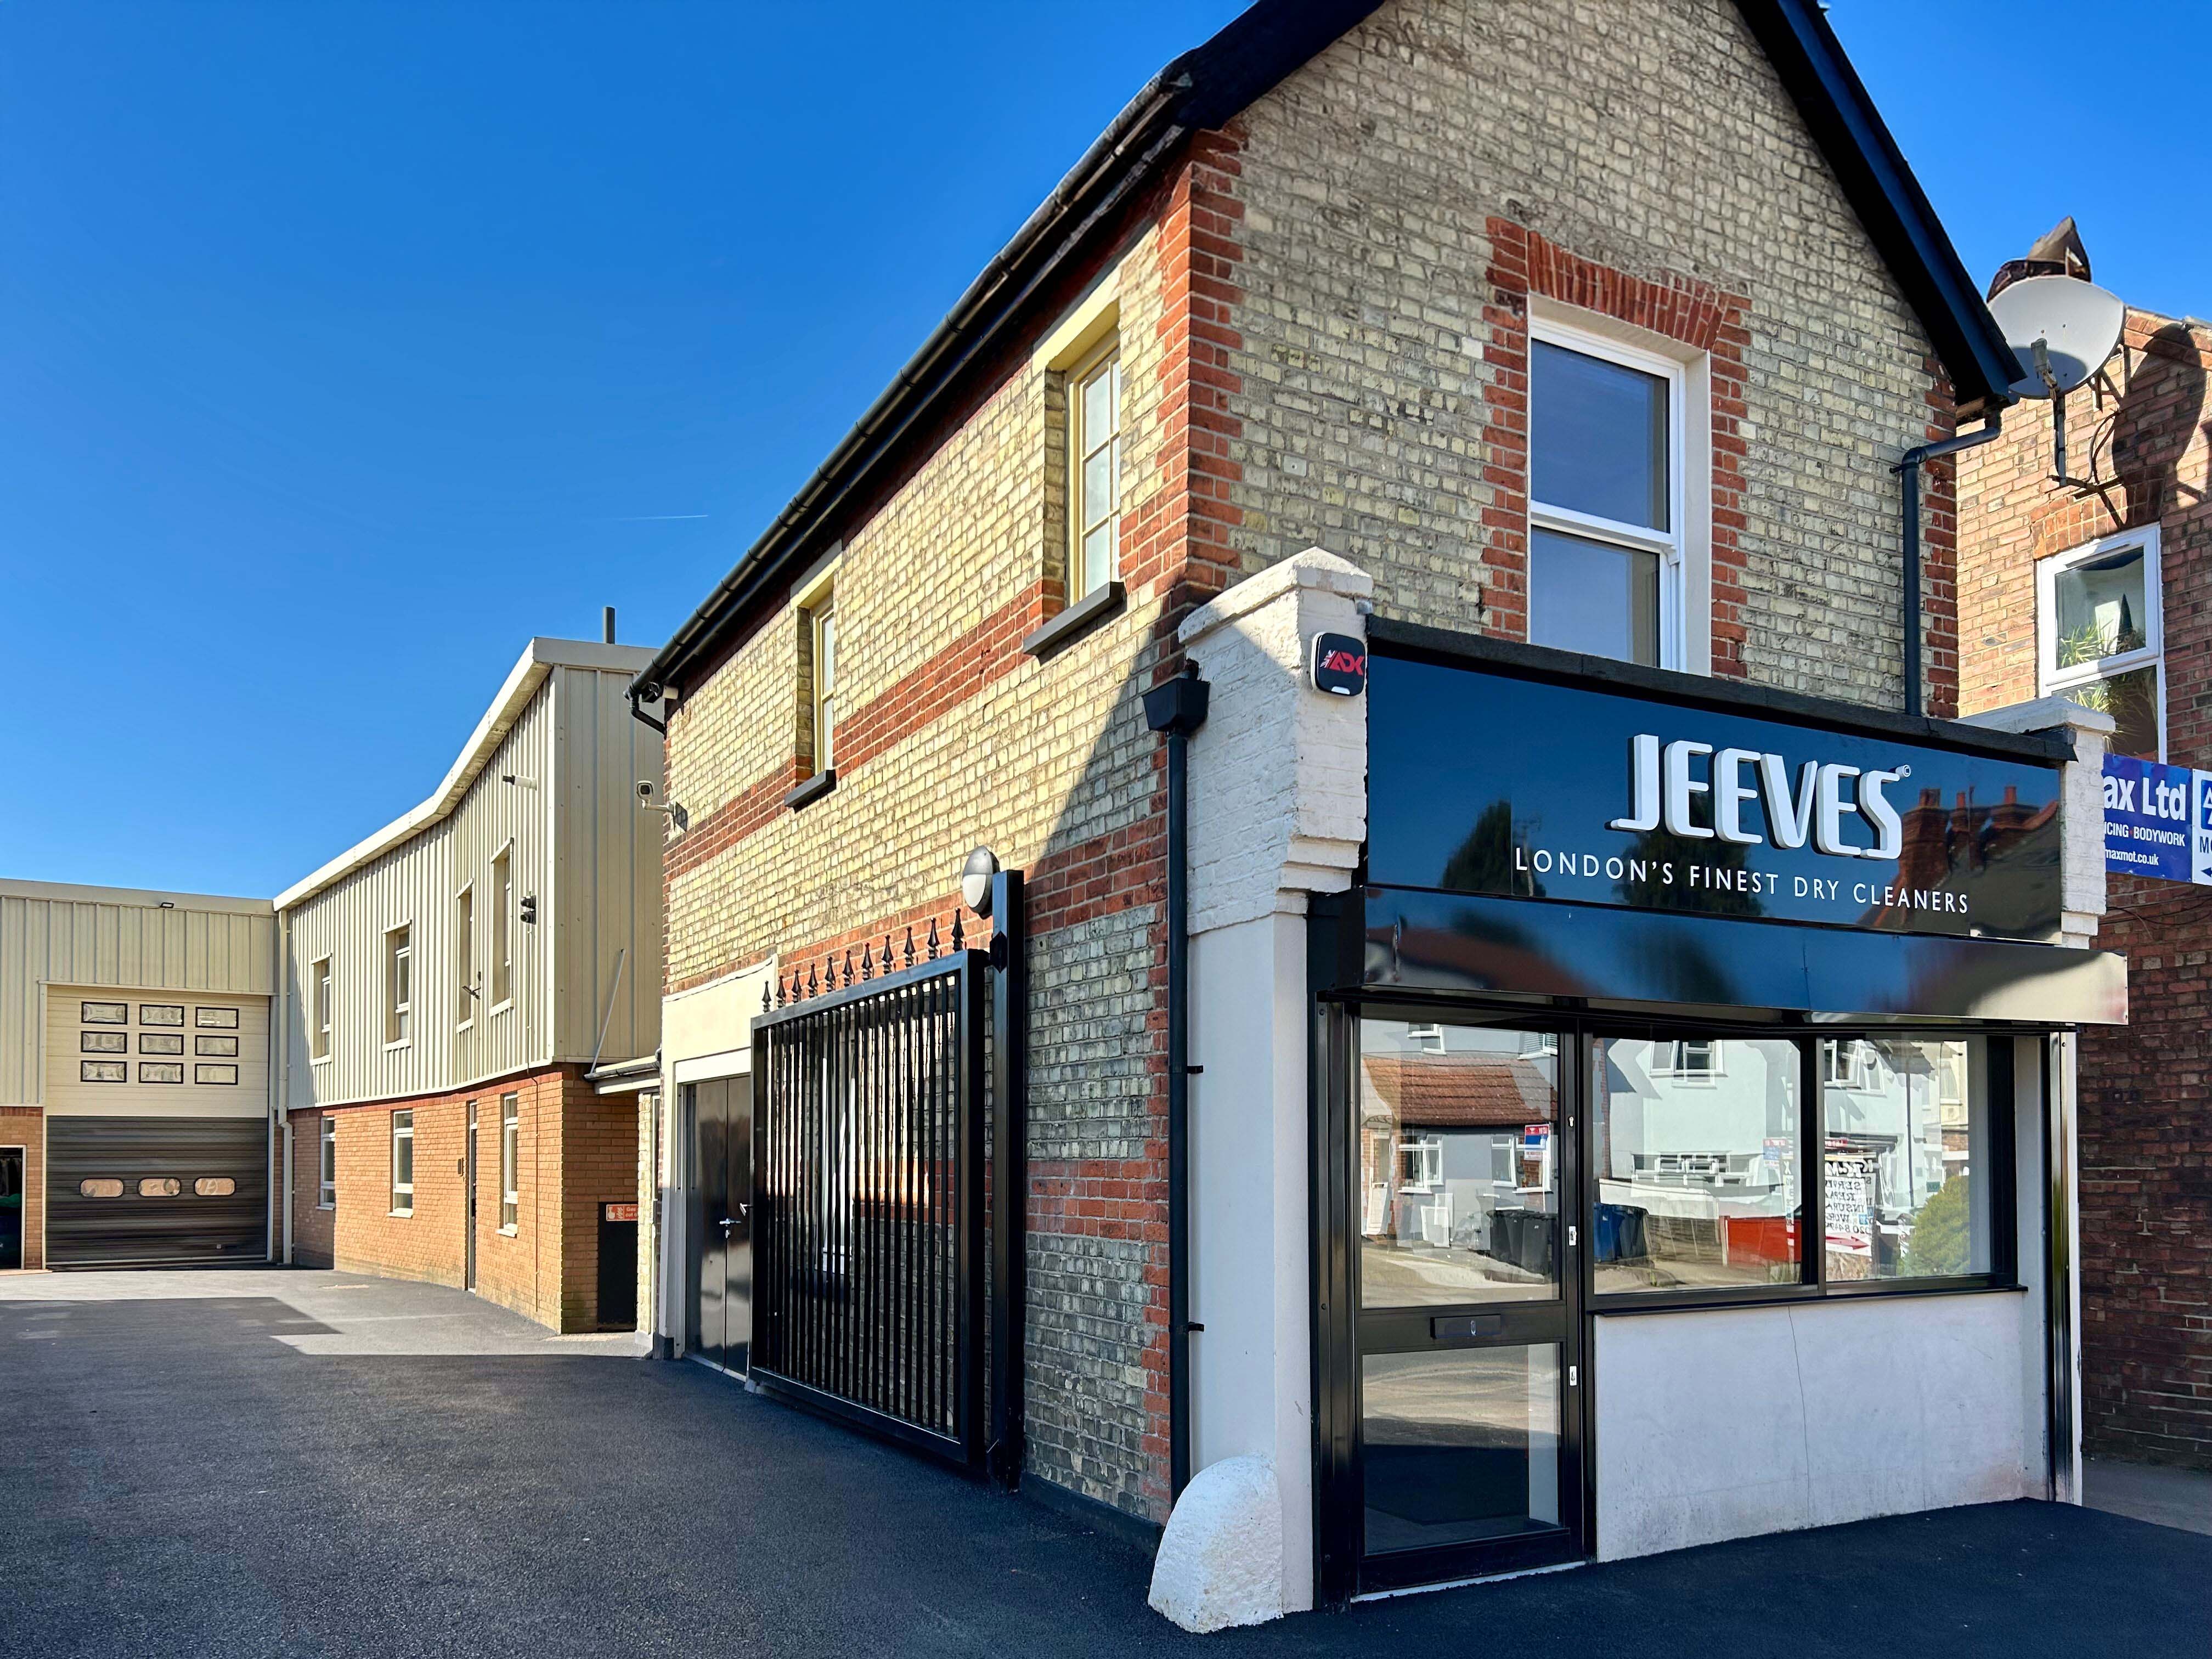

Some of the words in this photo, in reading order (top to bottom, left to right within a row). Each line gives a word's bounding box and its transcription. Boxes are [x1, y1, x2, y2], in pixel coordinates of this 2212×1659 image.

[1609, 733, 1903, 861] JEEVES
[2142, 777, 2186, 821] Ltd
[2134, 826, 2186, 847] BODYWORK
[1516, 848, 1673, 884] LONDON'S
[1690, 865, 1779, 895] FINEST
[1795, 876, 1839, 901] DRY
[1853, 883, 1968, 913] CLEANERS
